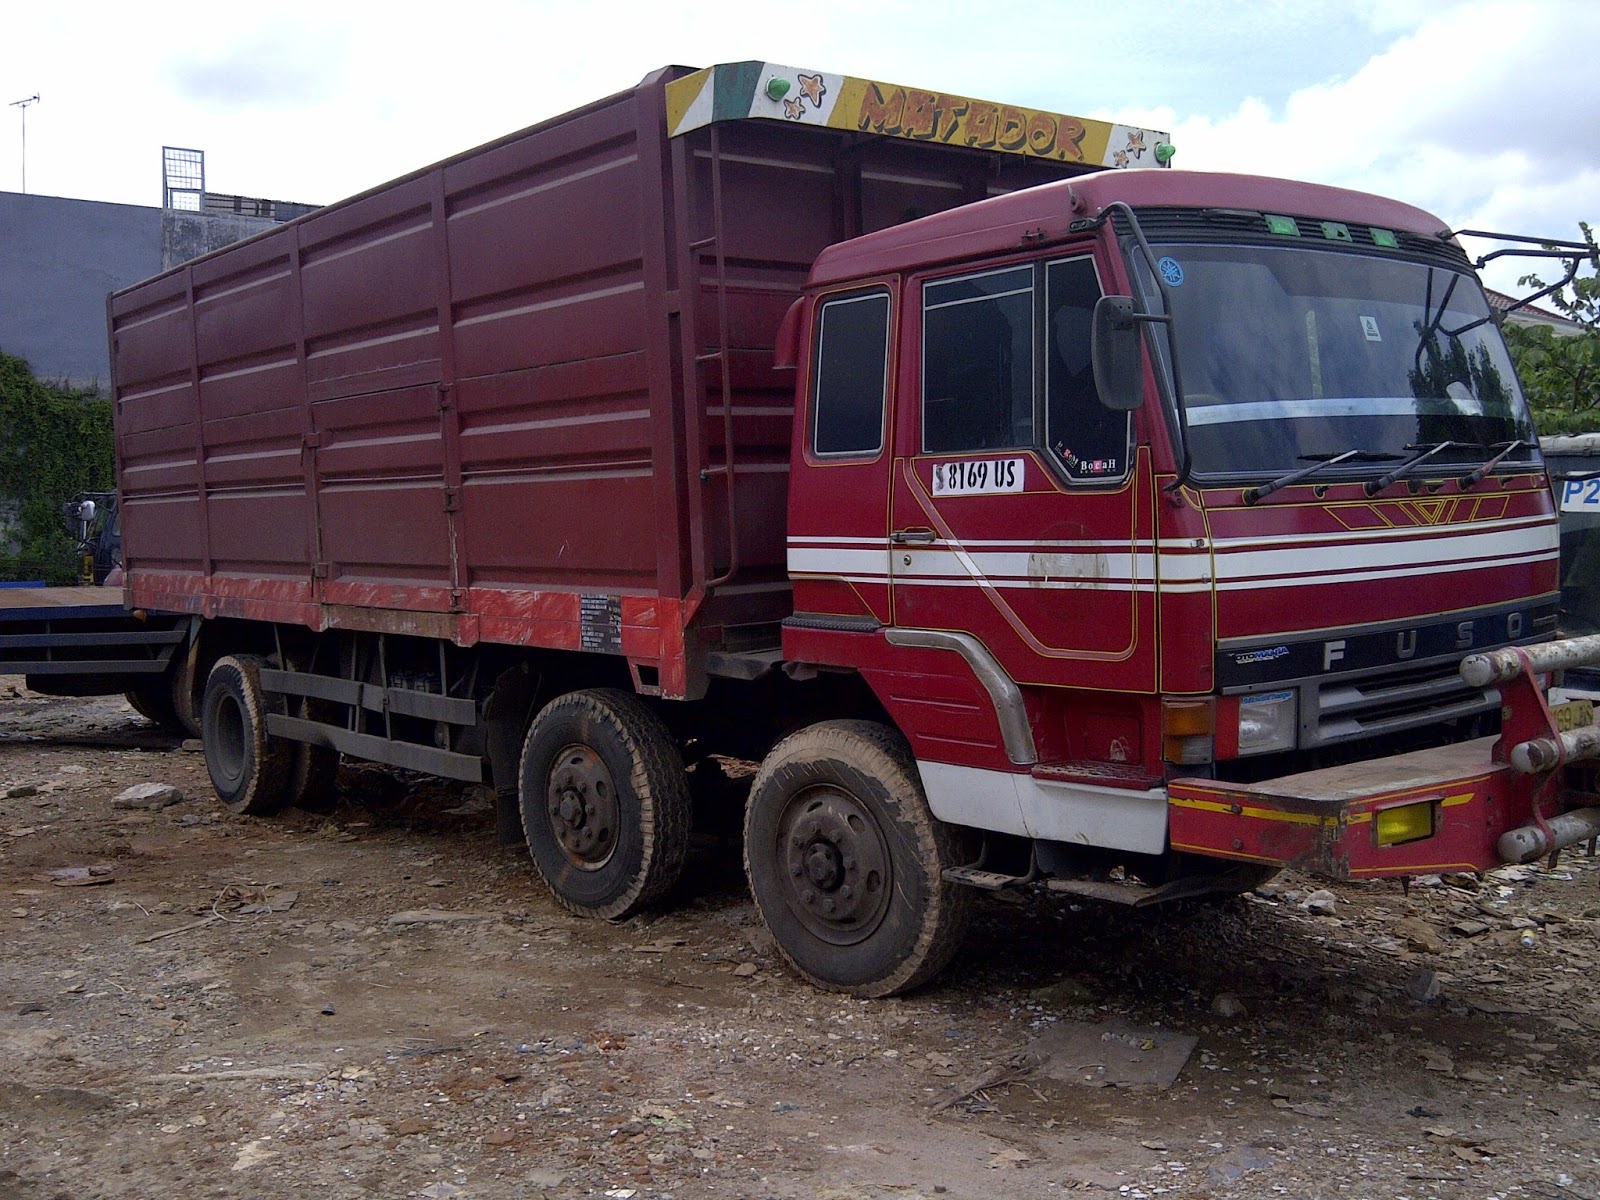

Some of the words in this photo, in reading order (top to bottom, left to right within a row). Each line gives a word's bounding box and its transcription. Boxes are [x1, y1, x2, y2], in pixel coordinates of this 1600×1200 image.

[858, 82, 1087, 161] MATADOR
[949, 462, 988, 489] 8169
[994, 460, 1016, 488] US
[1323, 612, 1522, 670] FUSO
